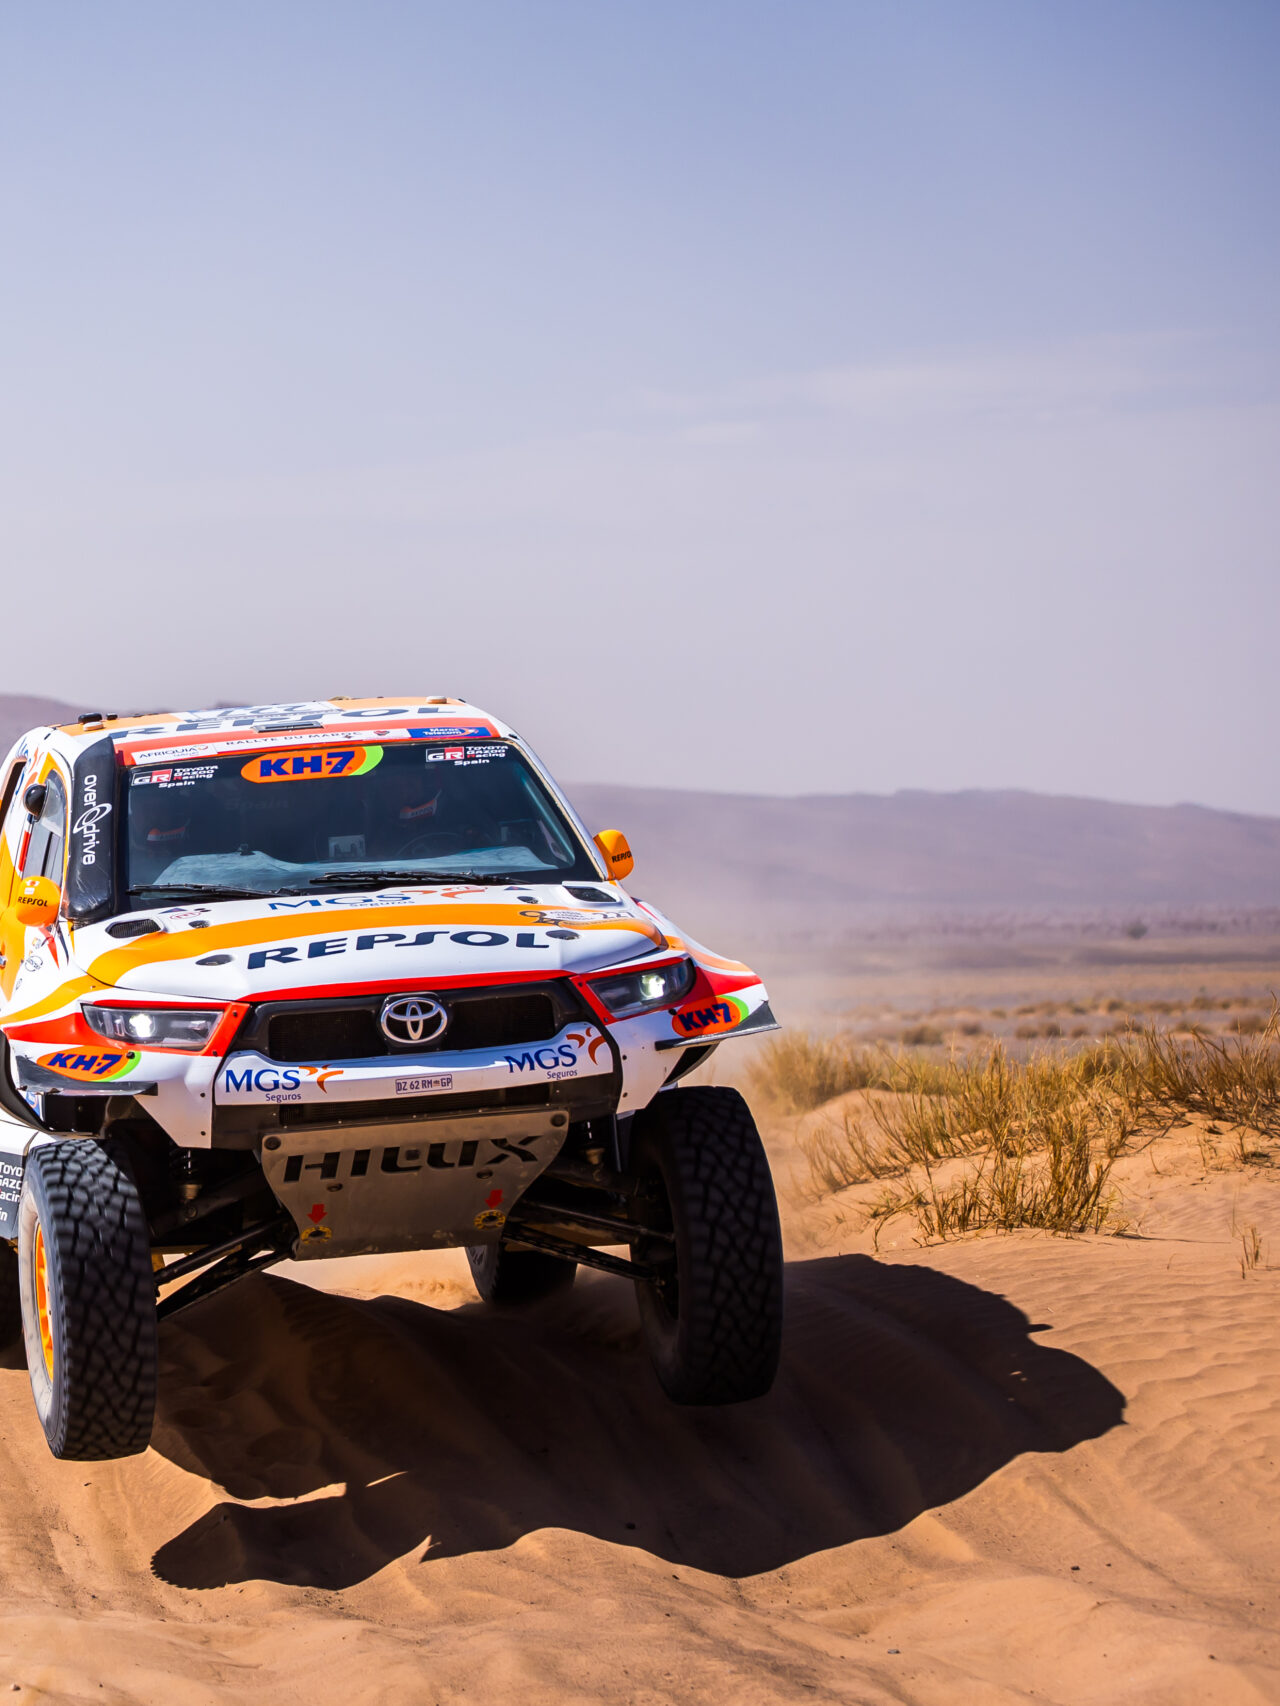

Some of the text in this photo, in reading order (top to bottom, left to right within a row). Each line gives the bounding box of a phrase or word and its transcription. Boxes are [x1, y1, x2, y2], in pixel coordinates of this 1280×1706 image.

[140, 747, 198, 759] AFRIQUIA
[427, 752, 463, 761] GR
[173, 769, 215, 777] GAZOO
[174, 765, 219, 773] TOYOTA
[133, 774, 170, 784] GR
[158, 780, 196, 788] Spain
[17, 896, 49, 907] REPSOL
[268, 893, 412, 910] MGS
[247, 931, 550, 970] REPSOL
[503, 1044, 578, 1074] MGS
[546, 1069, 578, 1080] Seguros
[225, 1069, 301, 1093] MGS
[396, 1081, 408, 1092] DZ
[409, 1080, 420, 1090] 62
[440, 1077, 452, 1087] GP
[265, 1093, 302, 1103] Seguros
[283, 1135, 543, 1184] HILUX
